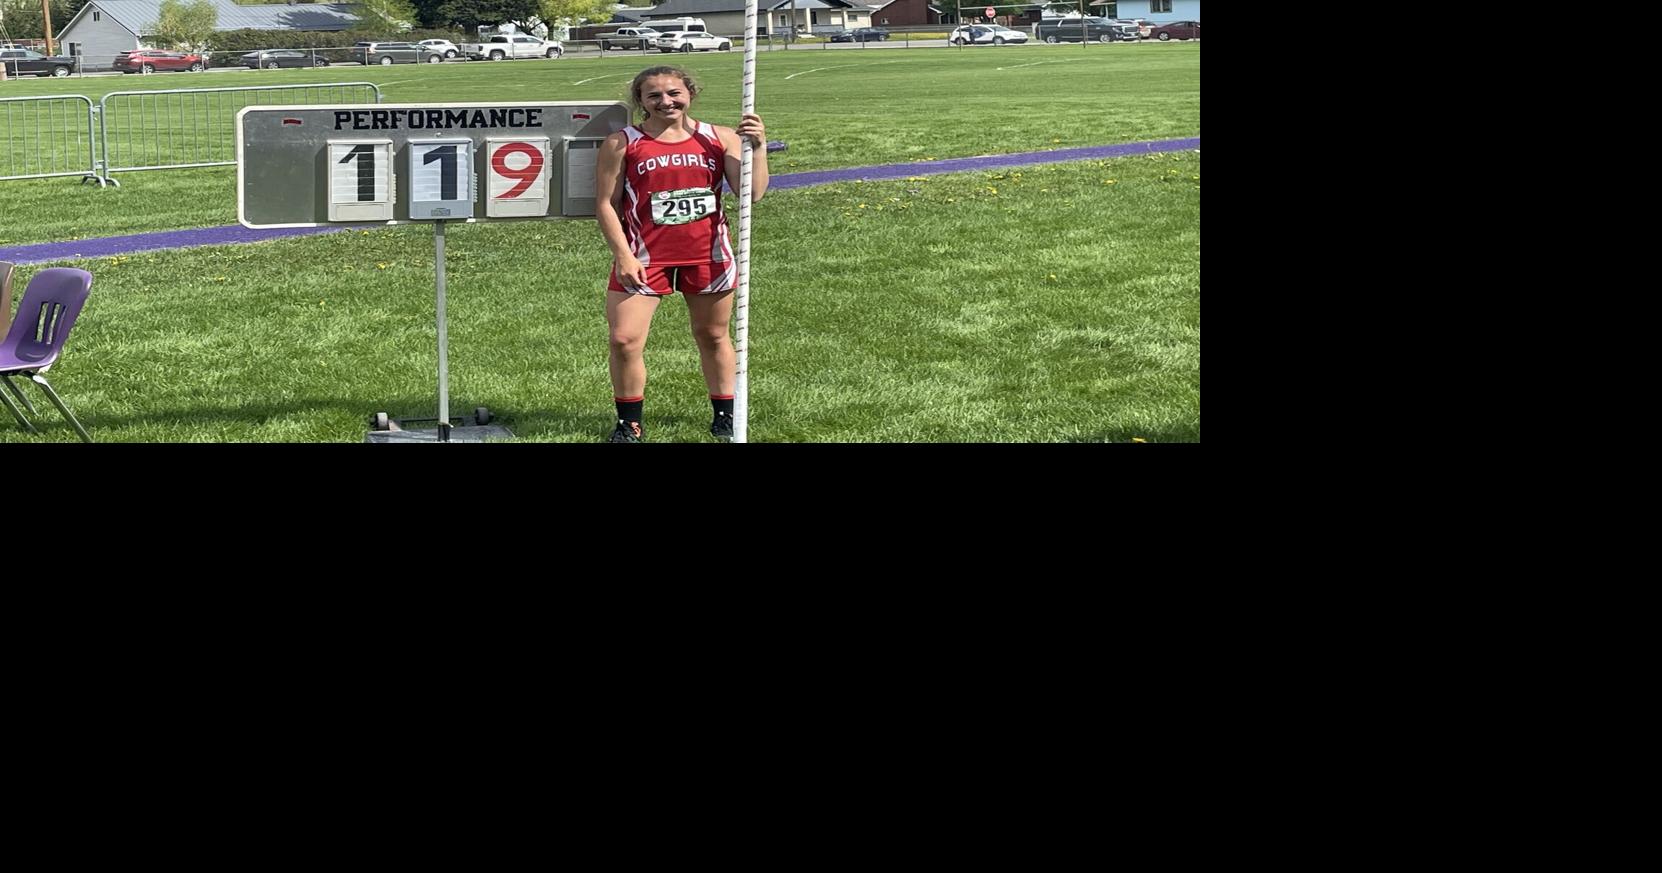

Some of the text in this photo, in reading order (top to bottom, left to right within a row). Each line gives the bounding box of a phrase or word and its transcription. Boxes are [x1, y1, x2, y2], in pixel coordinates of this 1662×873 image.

[334, 108, 543, 130] PERFORMANCE
[637, 153, 716, 175] COWGIRLS
[662, 198, 707, 217] 295
